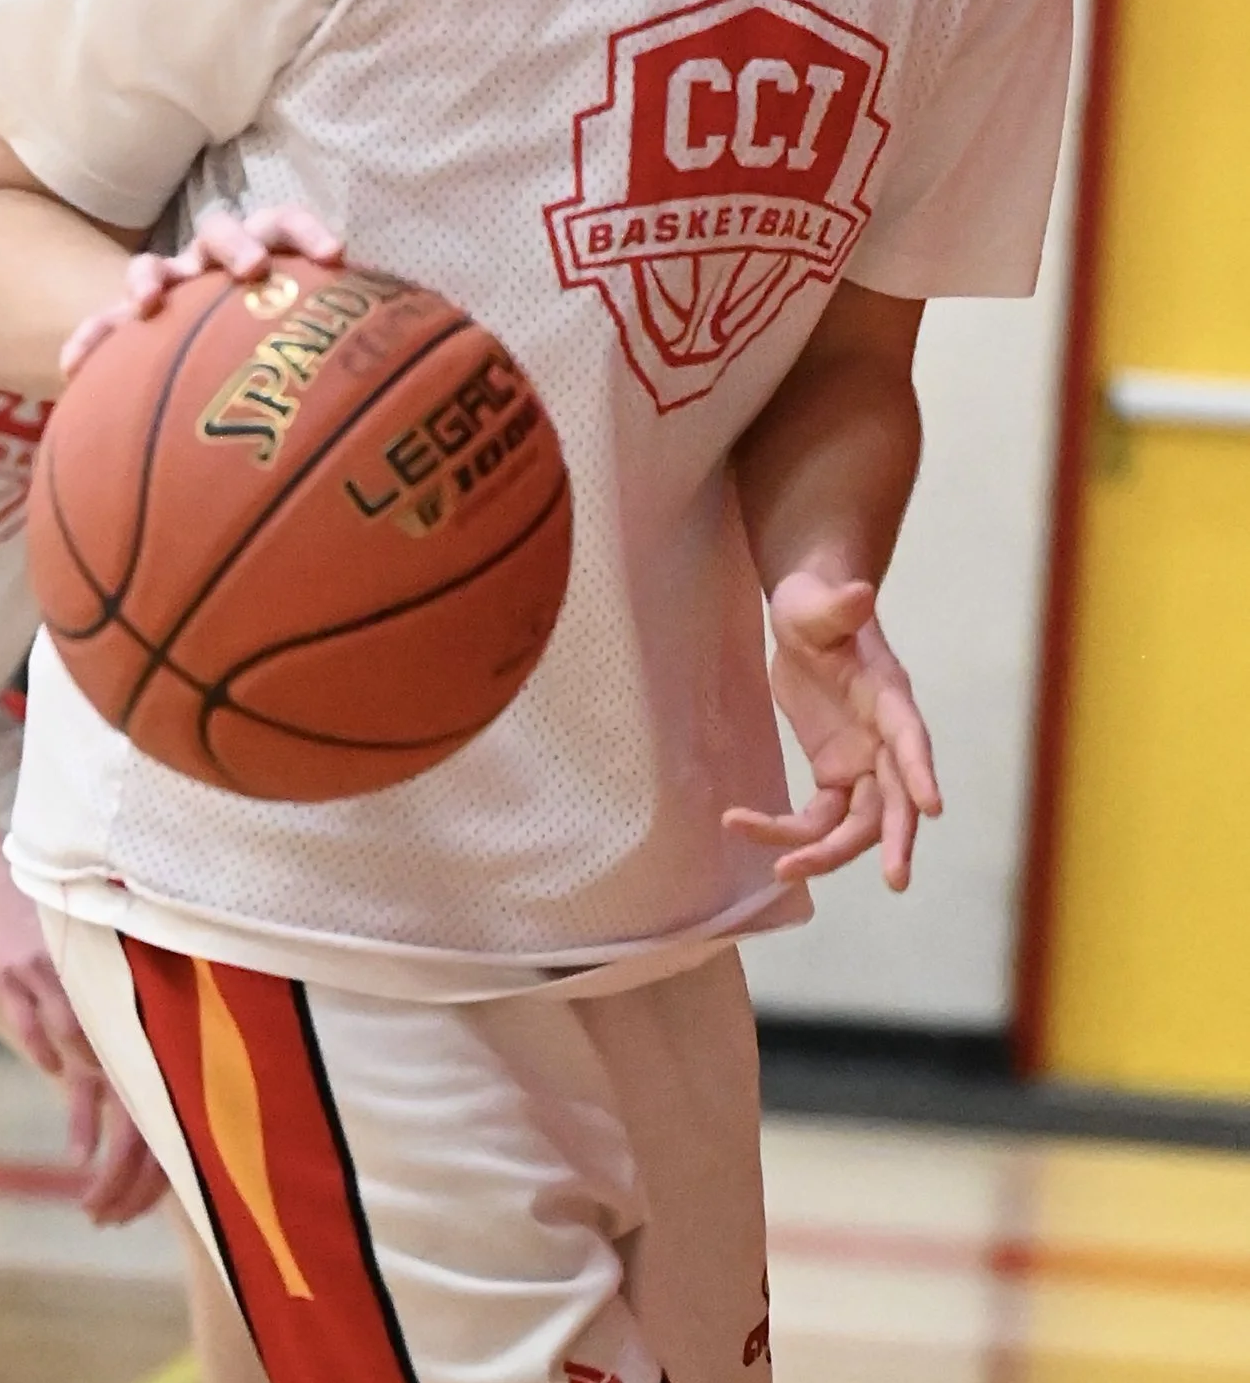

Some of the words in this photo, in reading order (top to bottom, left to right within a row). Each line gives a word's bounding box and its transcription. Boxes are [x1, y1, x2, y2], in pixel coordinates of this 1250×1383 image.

[663, 56, 845, 173] CCI
[587, 204, 834, 255] BASKETBALL
[345, 352, 522, 518] LEGAC
